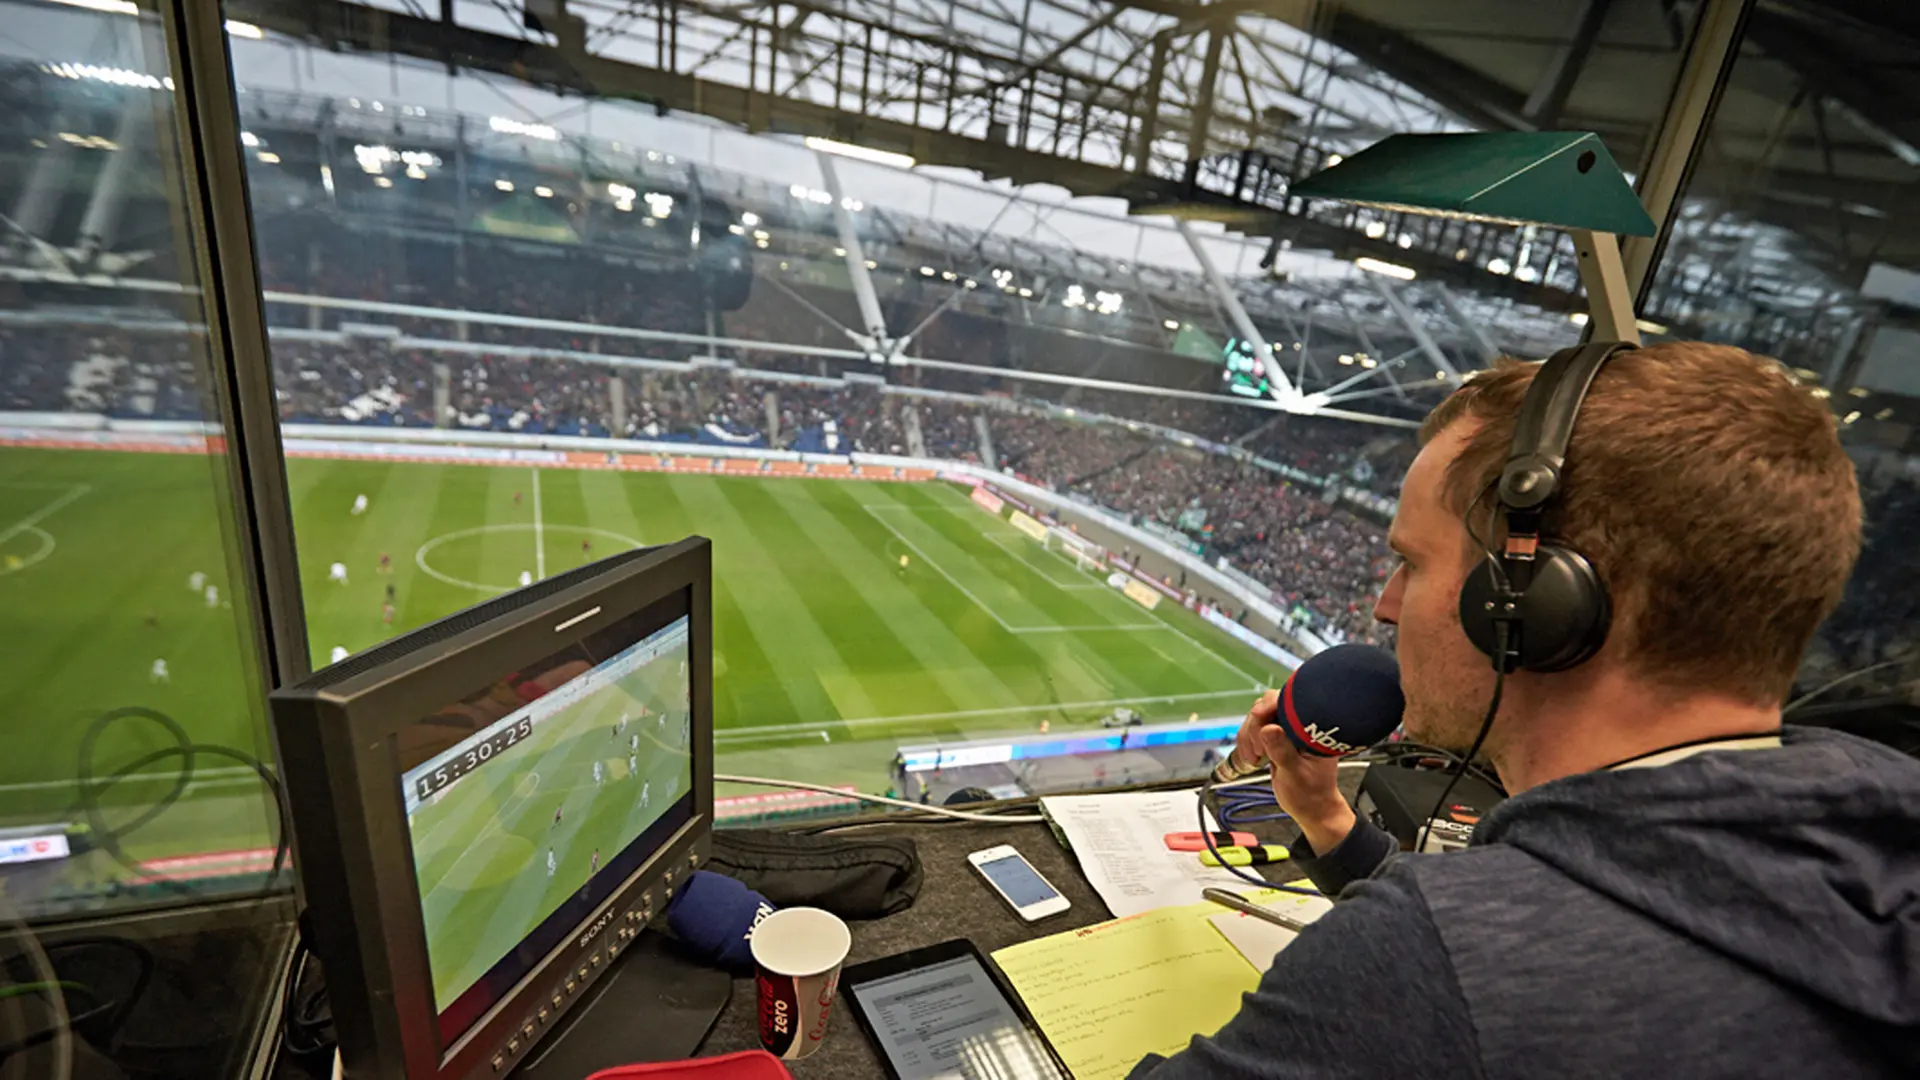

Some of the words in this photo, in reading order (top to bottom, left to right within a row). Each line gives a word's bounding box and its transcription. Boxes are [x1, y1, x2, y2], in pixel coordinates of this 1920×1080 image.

[420, 719, 530, 796] 15:30:25
[580, 907, 615, 948] SONY
[774, 999, 788, 1034] zero
